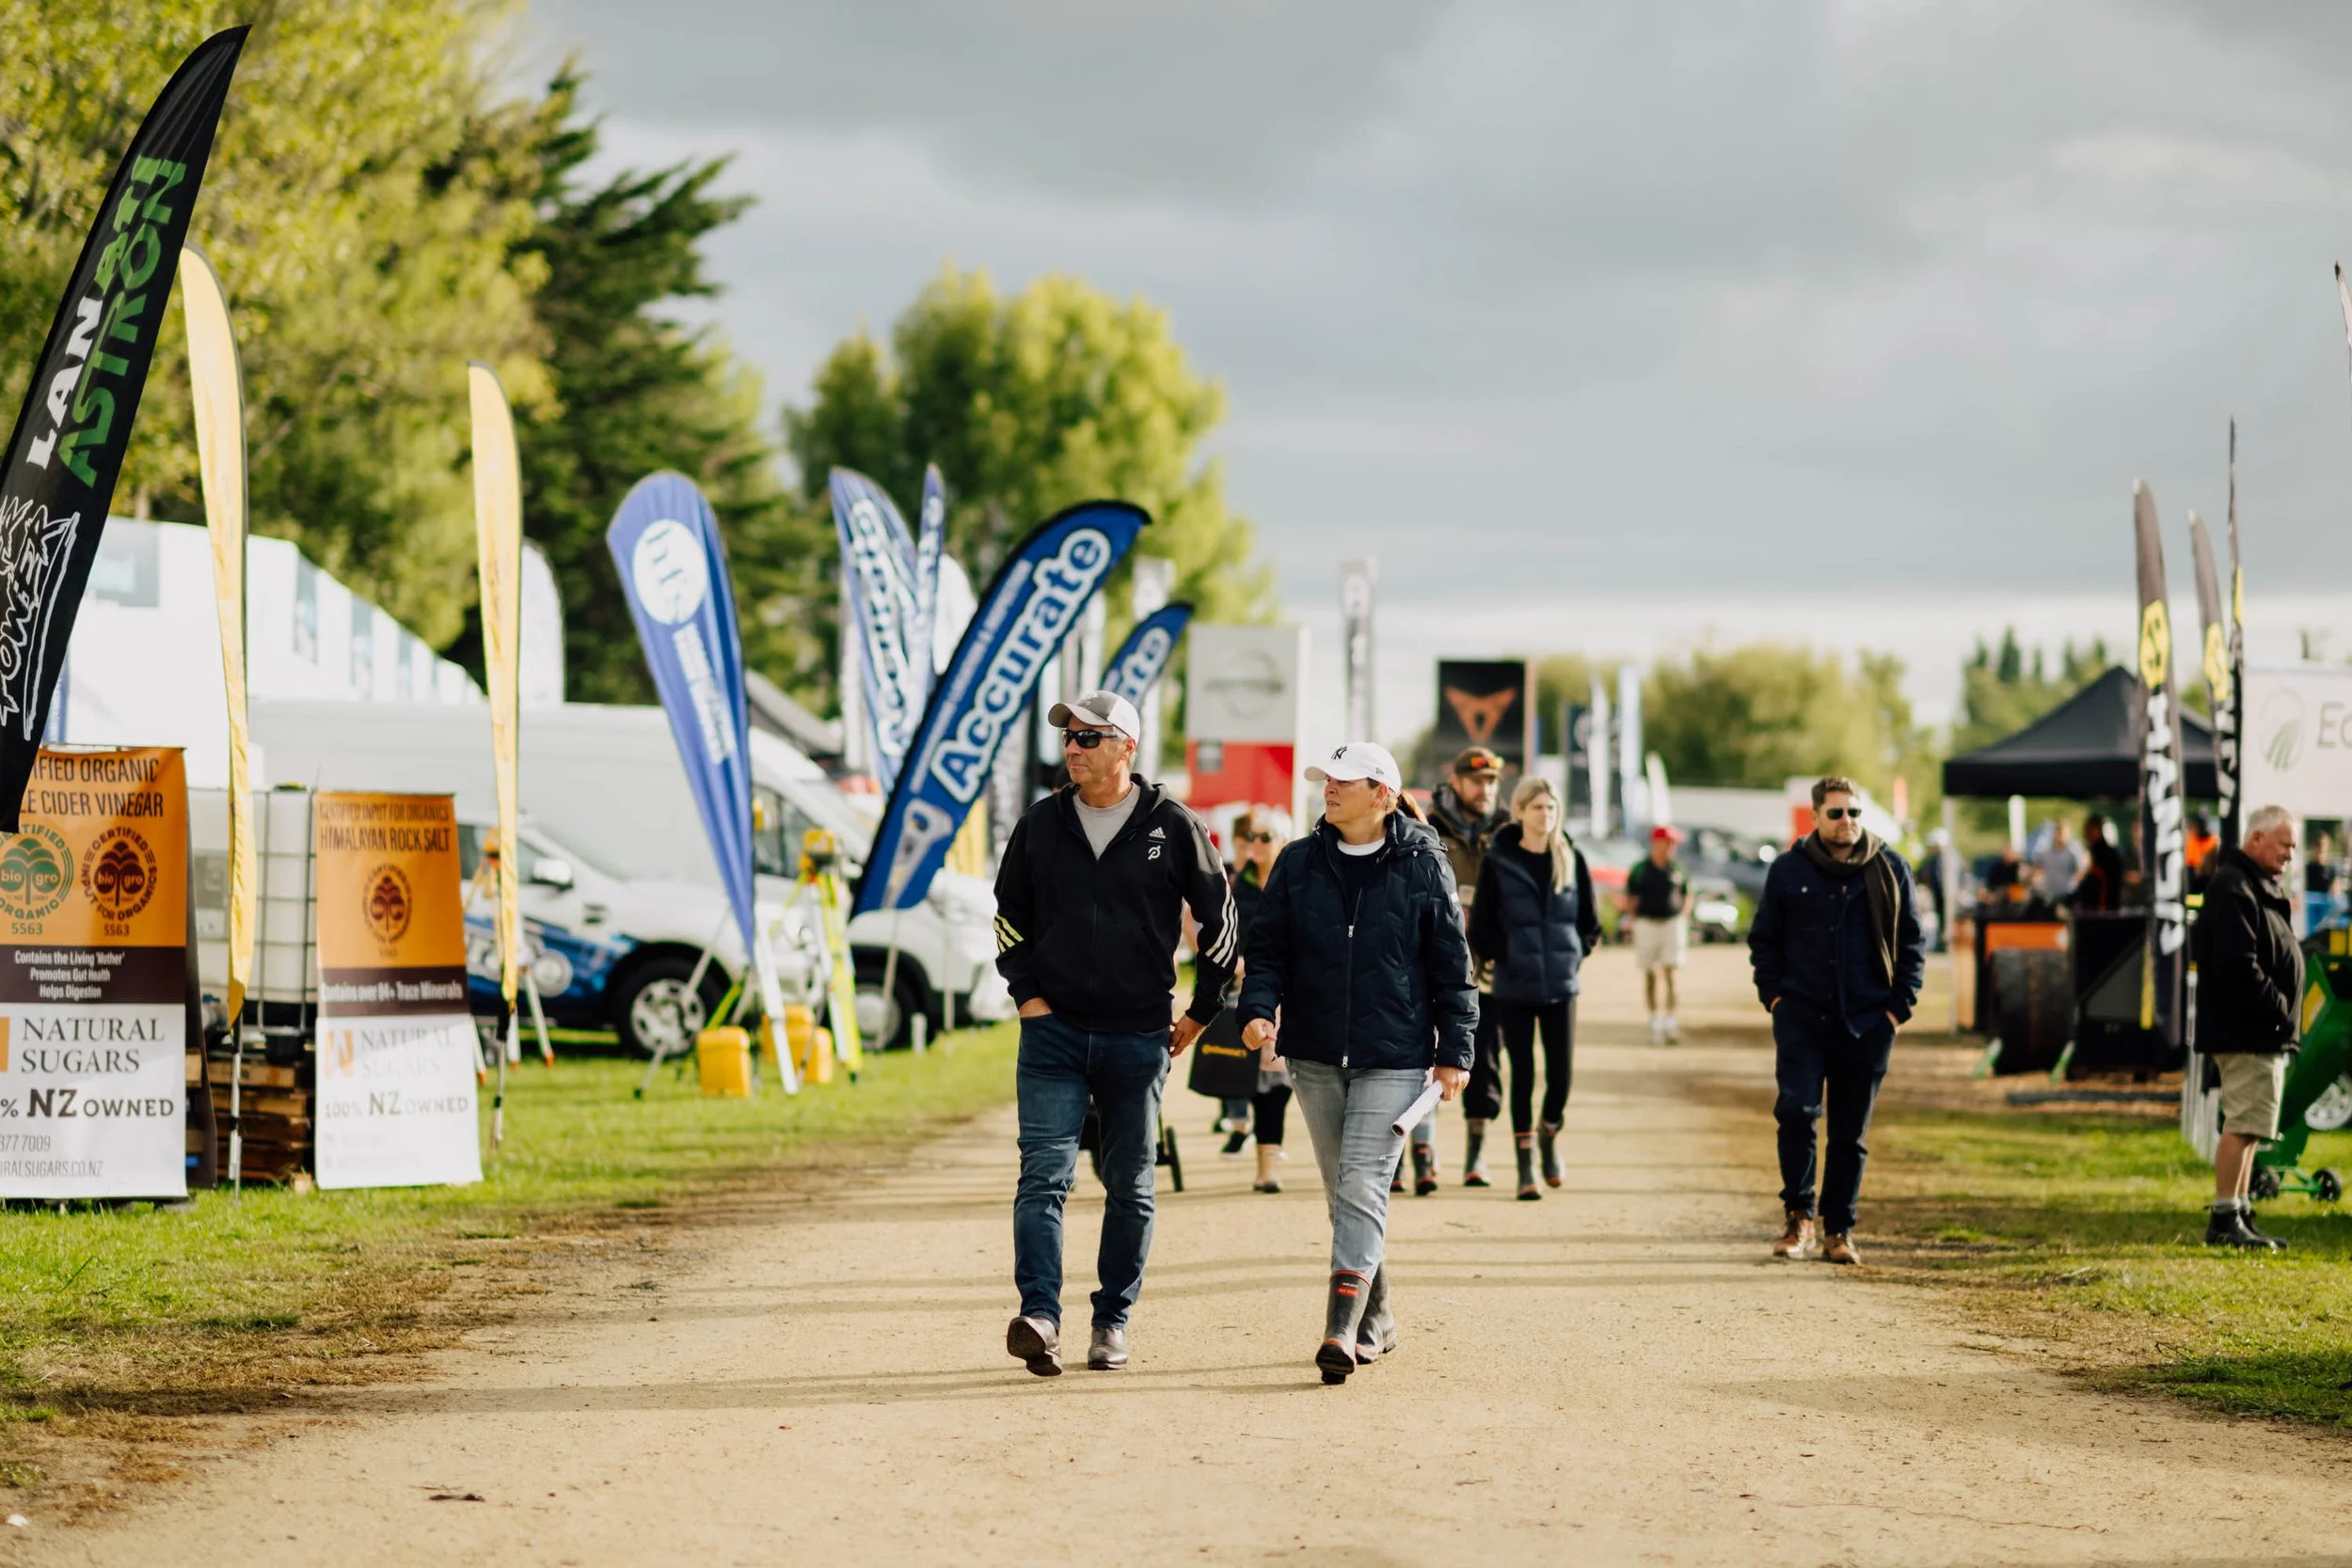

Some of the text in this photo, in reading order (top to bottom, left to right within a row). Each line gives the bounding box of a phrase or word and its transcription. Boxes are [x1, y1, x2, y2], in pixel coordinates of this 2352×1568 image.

[57, 158, 187, 488] ASTRON
[932, 530, 1109, 801] Accurate
[80, 757, 160, 783] ORGANIC
[41, 790, 92, 816] CIDER
[94, 792, 164, 817] VINEGAR
[321, 827, 451, 851] HIMALAYAN ROCK SALT
[36, 873, 58, 886] gro
[11, 923, 43, 935] 5563
[103, 924, 130, 937] 5563
[15, 950, 53, 964] Contains
[54, 950, 67, 964] the
[70, 951, 95, 967] Living
[30, 967, 72, 981] Promotes
[72, 968, 87, 981] Gut
[40, 985, 102, 1001] Helps Digestion
[24, 1017, 165, 1041] NATURAL
[21, 1048, 140, 1073] SUGARS
[26, 1088, 78, 1117] NZ
[83, 1099, 174, 1117] OWNED
[369, 1091, 402, 1117] NZ
[405, 1097, 469, 1116] OWNED
[22, 1134, 51, 1152] 7009
